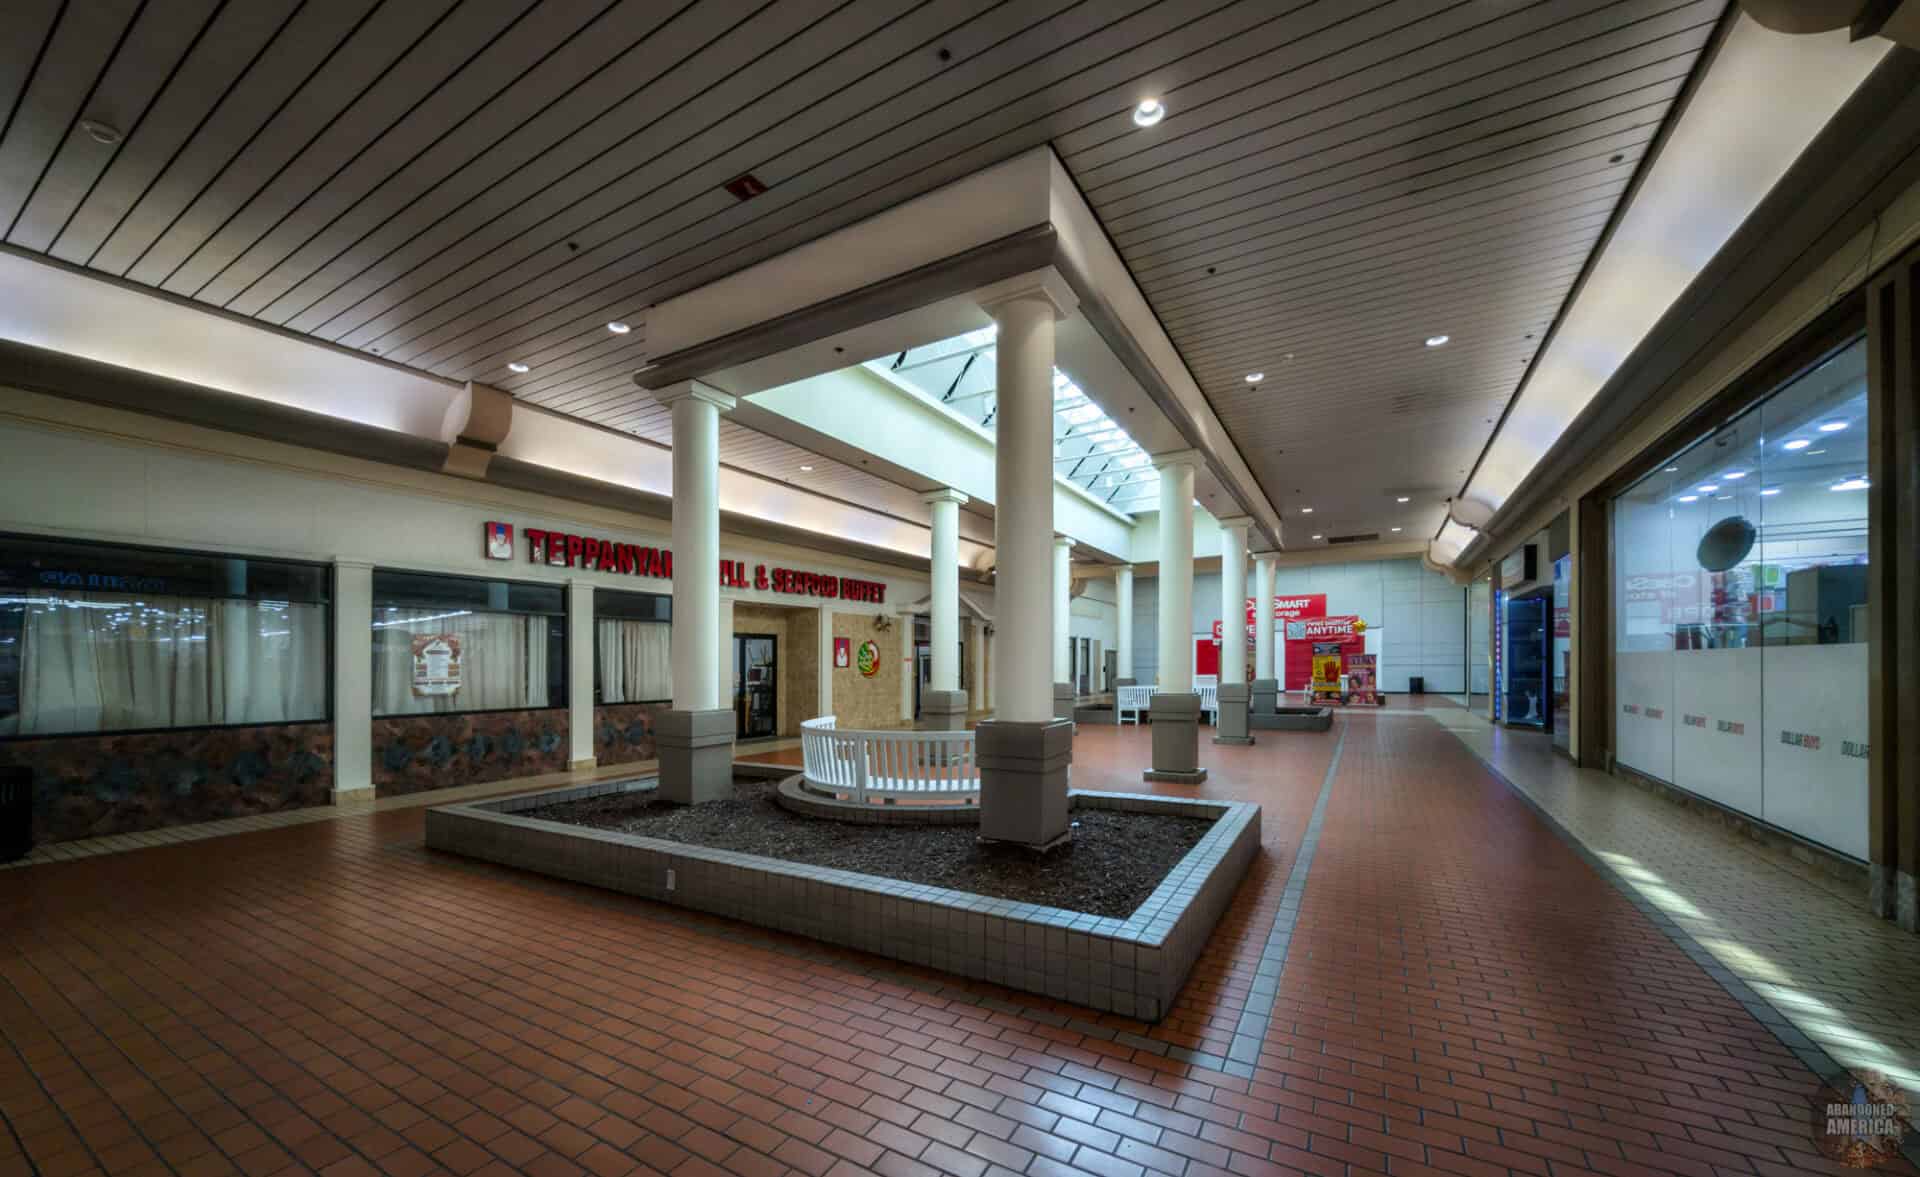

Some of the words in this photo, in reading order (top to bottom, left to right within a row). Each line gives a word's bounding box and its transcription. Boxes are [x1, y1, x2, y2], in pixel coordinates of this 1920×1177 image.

[525, 528, 672, 578] TEPPANYA
[719, 560, 749, 588] ILL
[755, 564, 769, 590] &
[772, 567, 838, 598] SEAFOOD
[840, 577, 886, 603] BUFFET
[1306, 625, 1352, 635] ANYTIME
